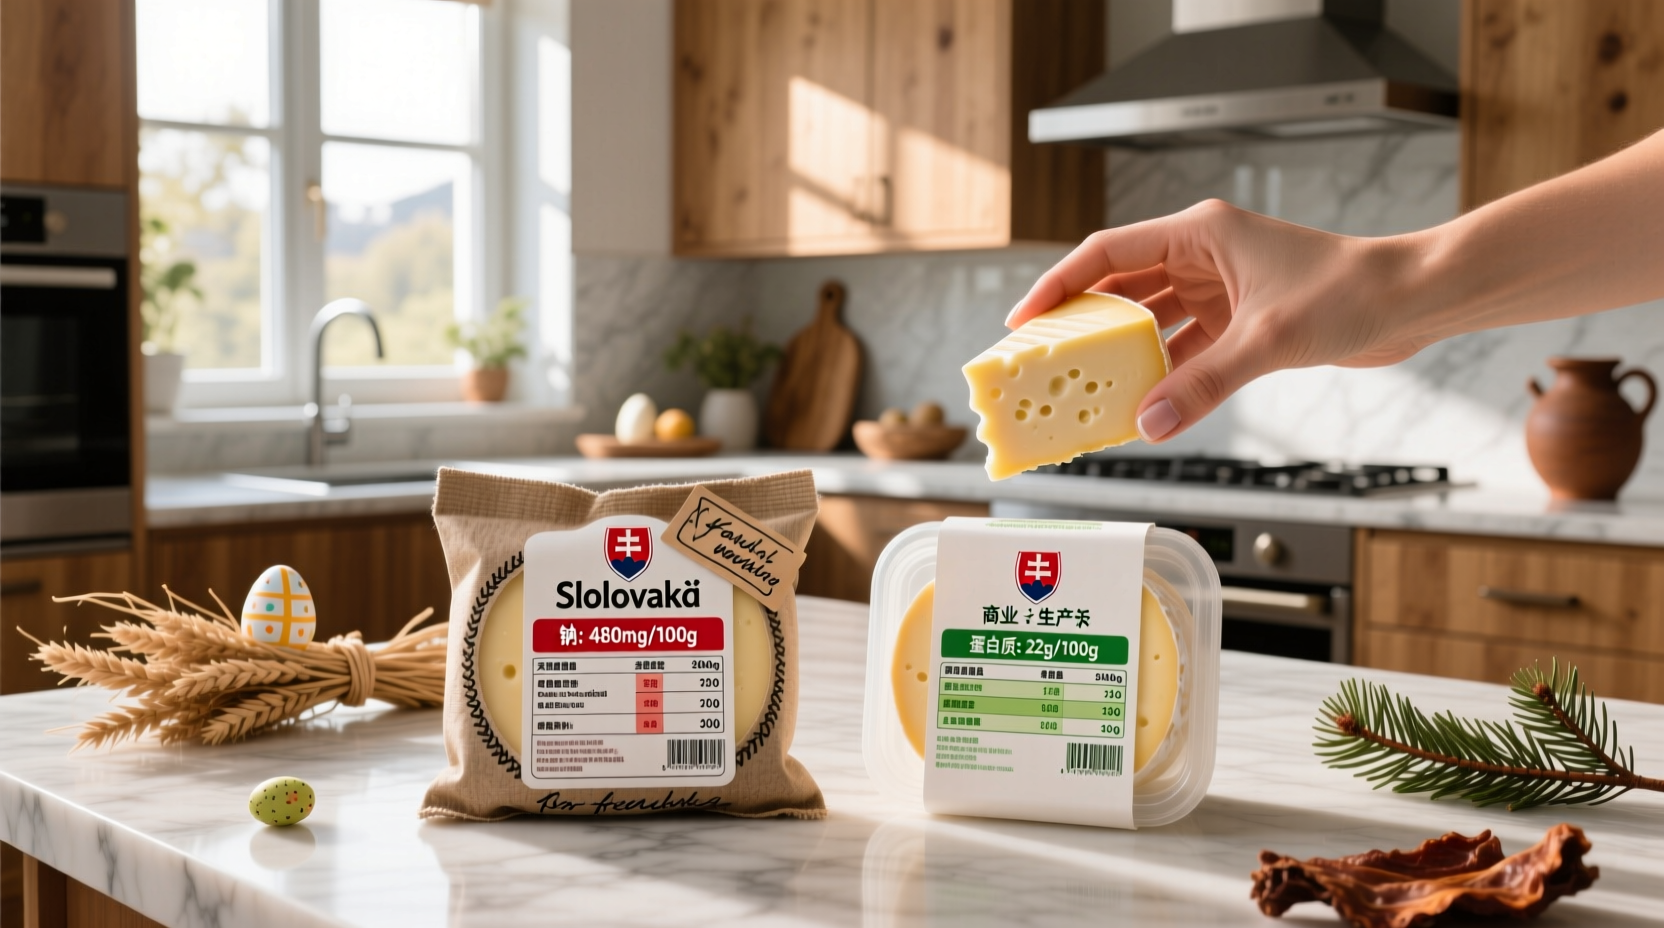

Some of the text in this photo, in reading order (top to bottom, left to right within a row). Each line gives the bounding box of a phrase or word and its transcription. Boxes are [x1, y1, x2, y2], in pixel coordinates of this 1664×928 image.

[982, 604, 1019, 625] 商业
[588, 624, 698, 648] 480mg/100g
[969, 634, 1099, 662] 蛋白质: 22g/100g
